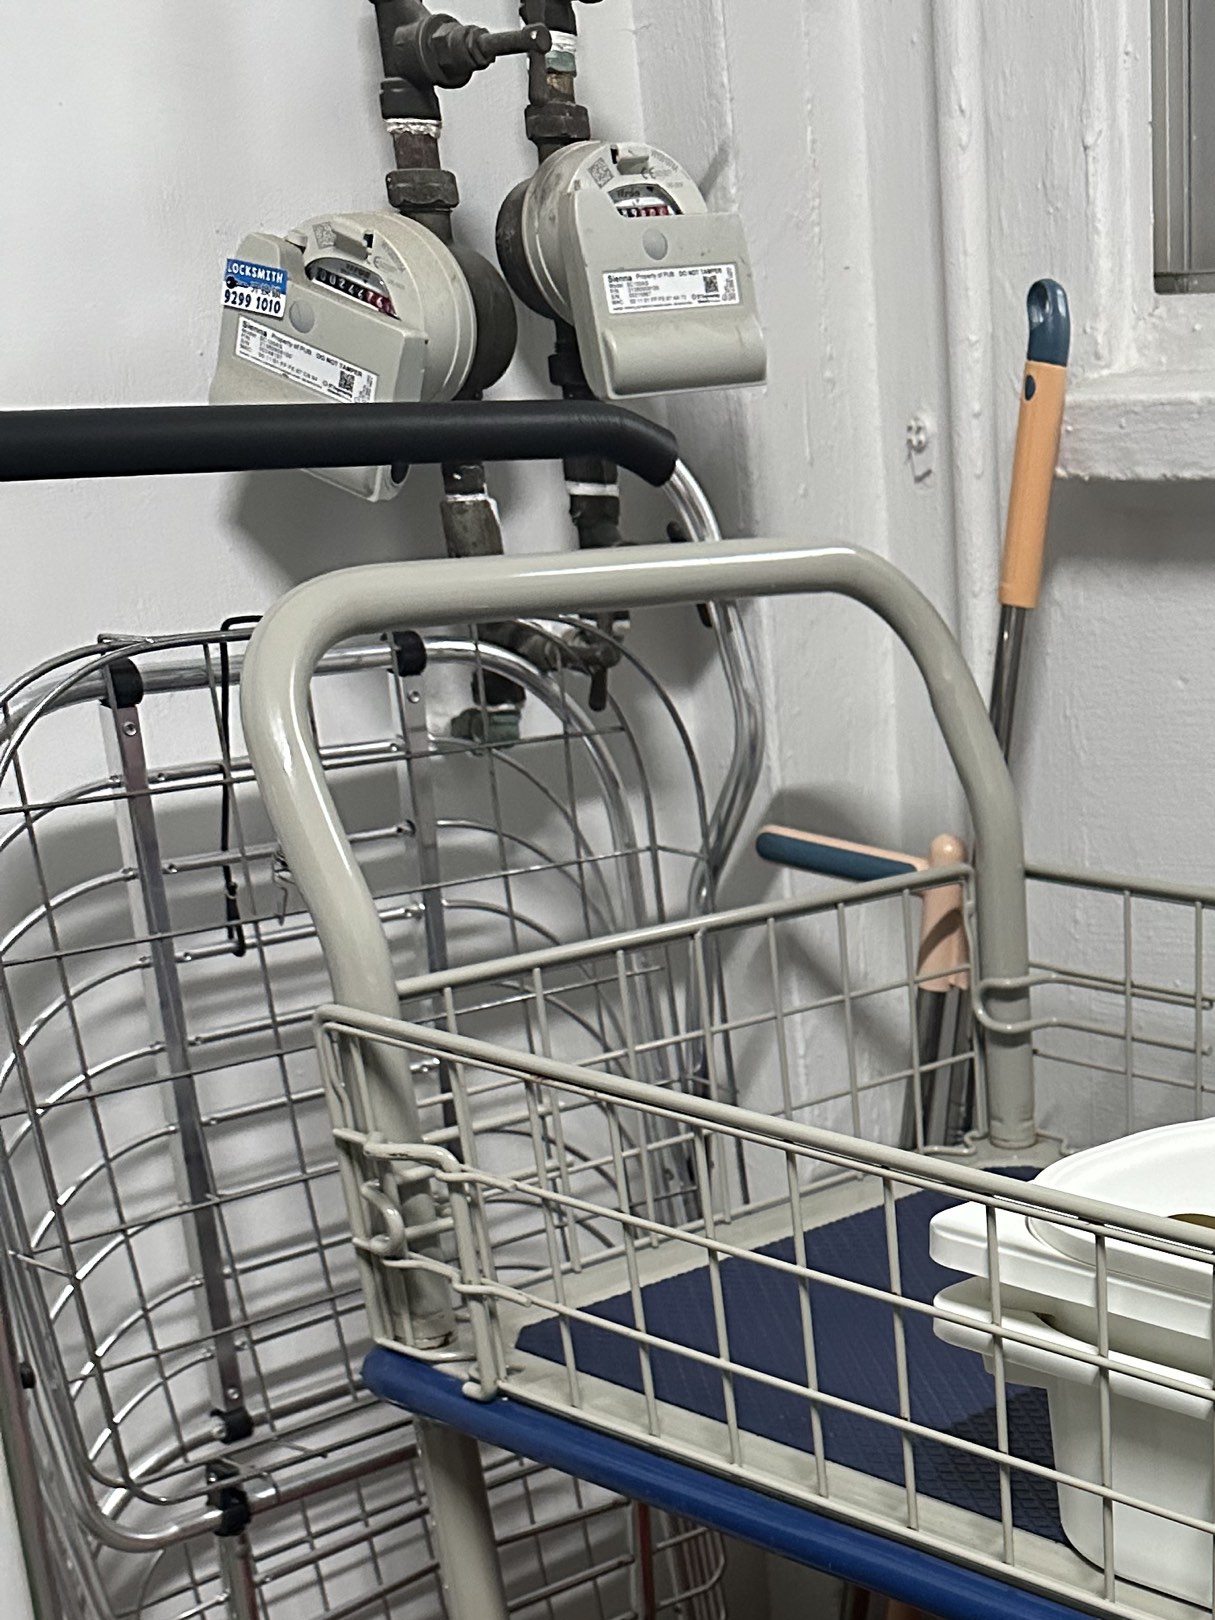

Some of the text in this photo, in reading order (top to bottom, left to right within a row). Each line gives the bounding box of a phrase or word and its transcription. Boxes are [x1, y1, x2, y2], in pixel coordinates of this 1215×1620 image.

[228, 263, 283, 284] LOCKSMITH
[607, 275, 633, 283] Sienna
[700, 267, 722, 275] TAMPER
[224, 289, 282, 314] 9299 1010
[242, 320, 268, 338] Sienna
[271, 332, 294, 348] Property
